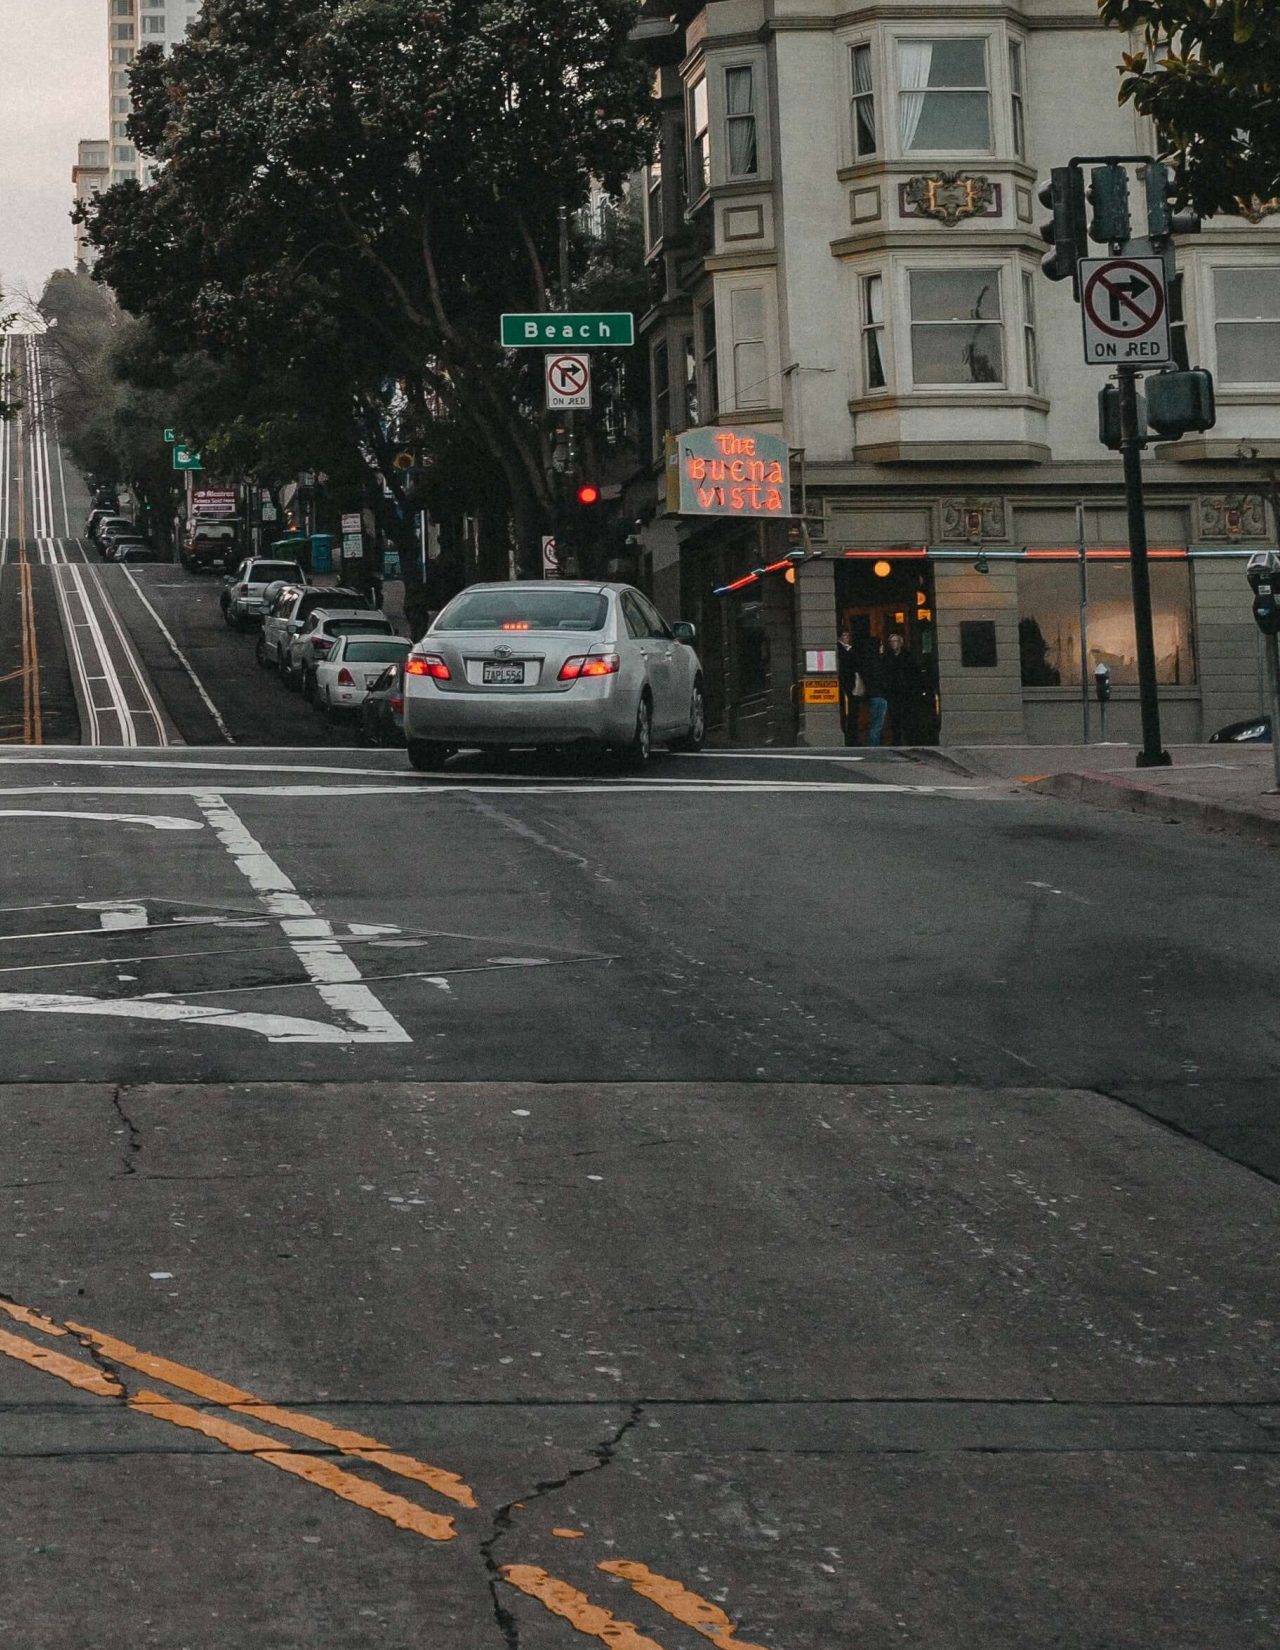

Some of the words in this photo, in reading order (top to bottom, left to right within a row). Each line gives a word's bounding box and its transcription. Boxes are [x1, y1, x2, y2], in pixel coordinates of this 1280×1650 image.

[524, 322, 611, 338] Beach
[1095, 343, 1117, 357] ON
[1127, 342, 1160, 356] RED
